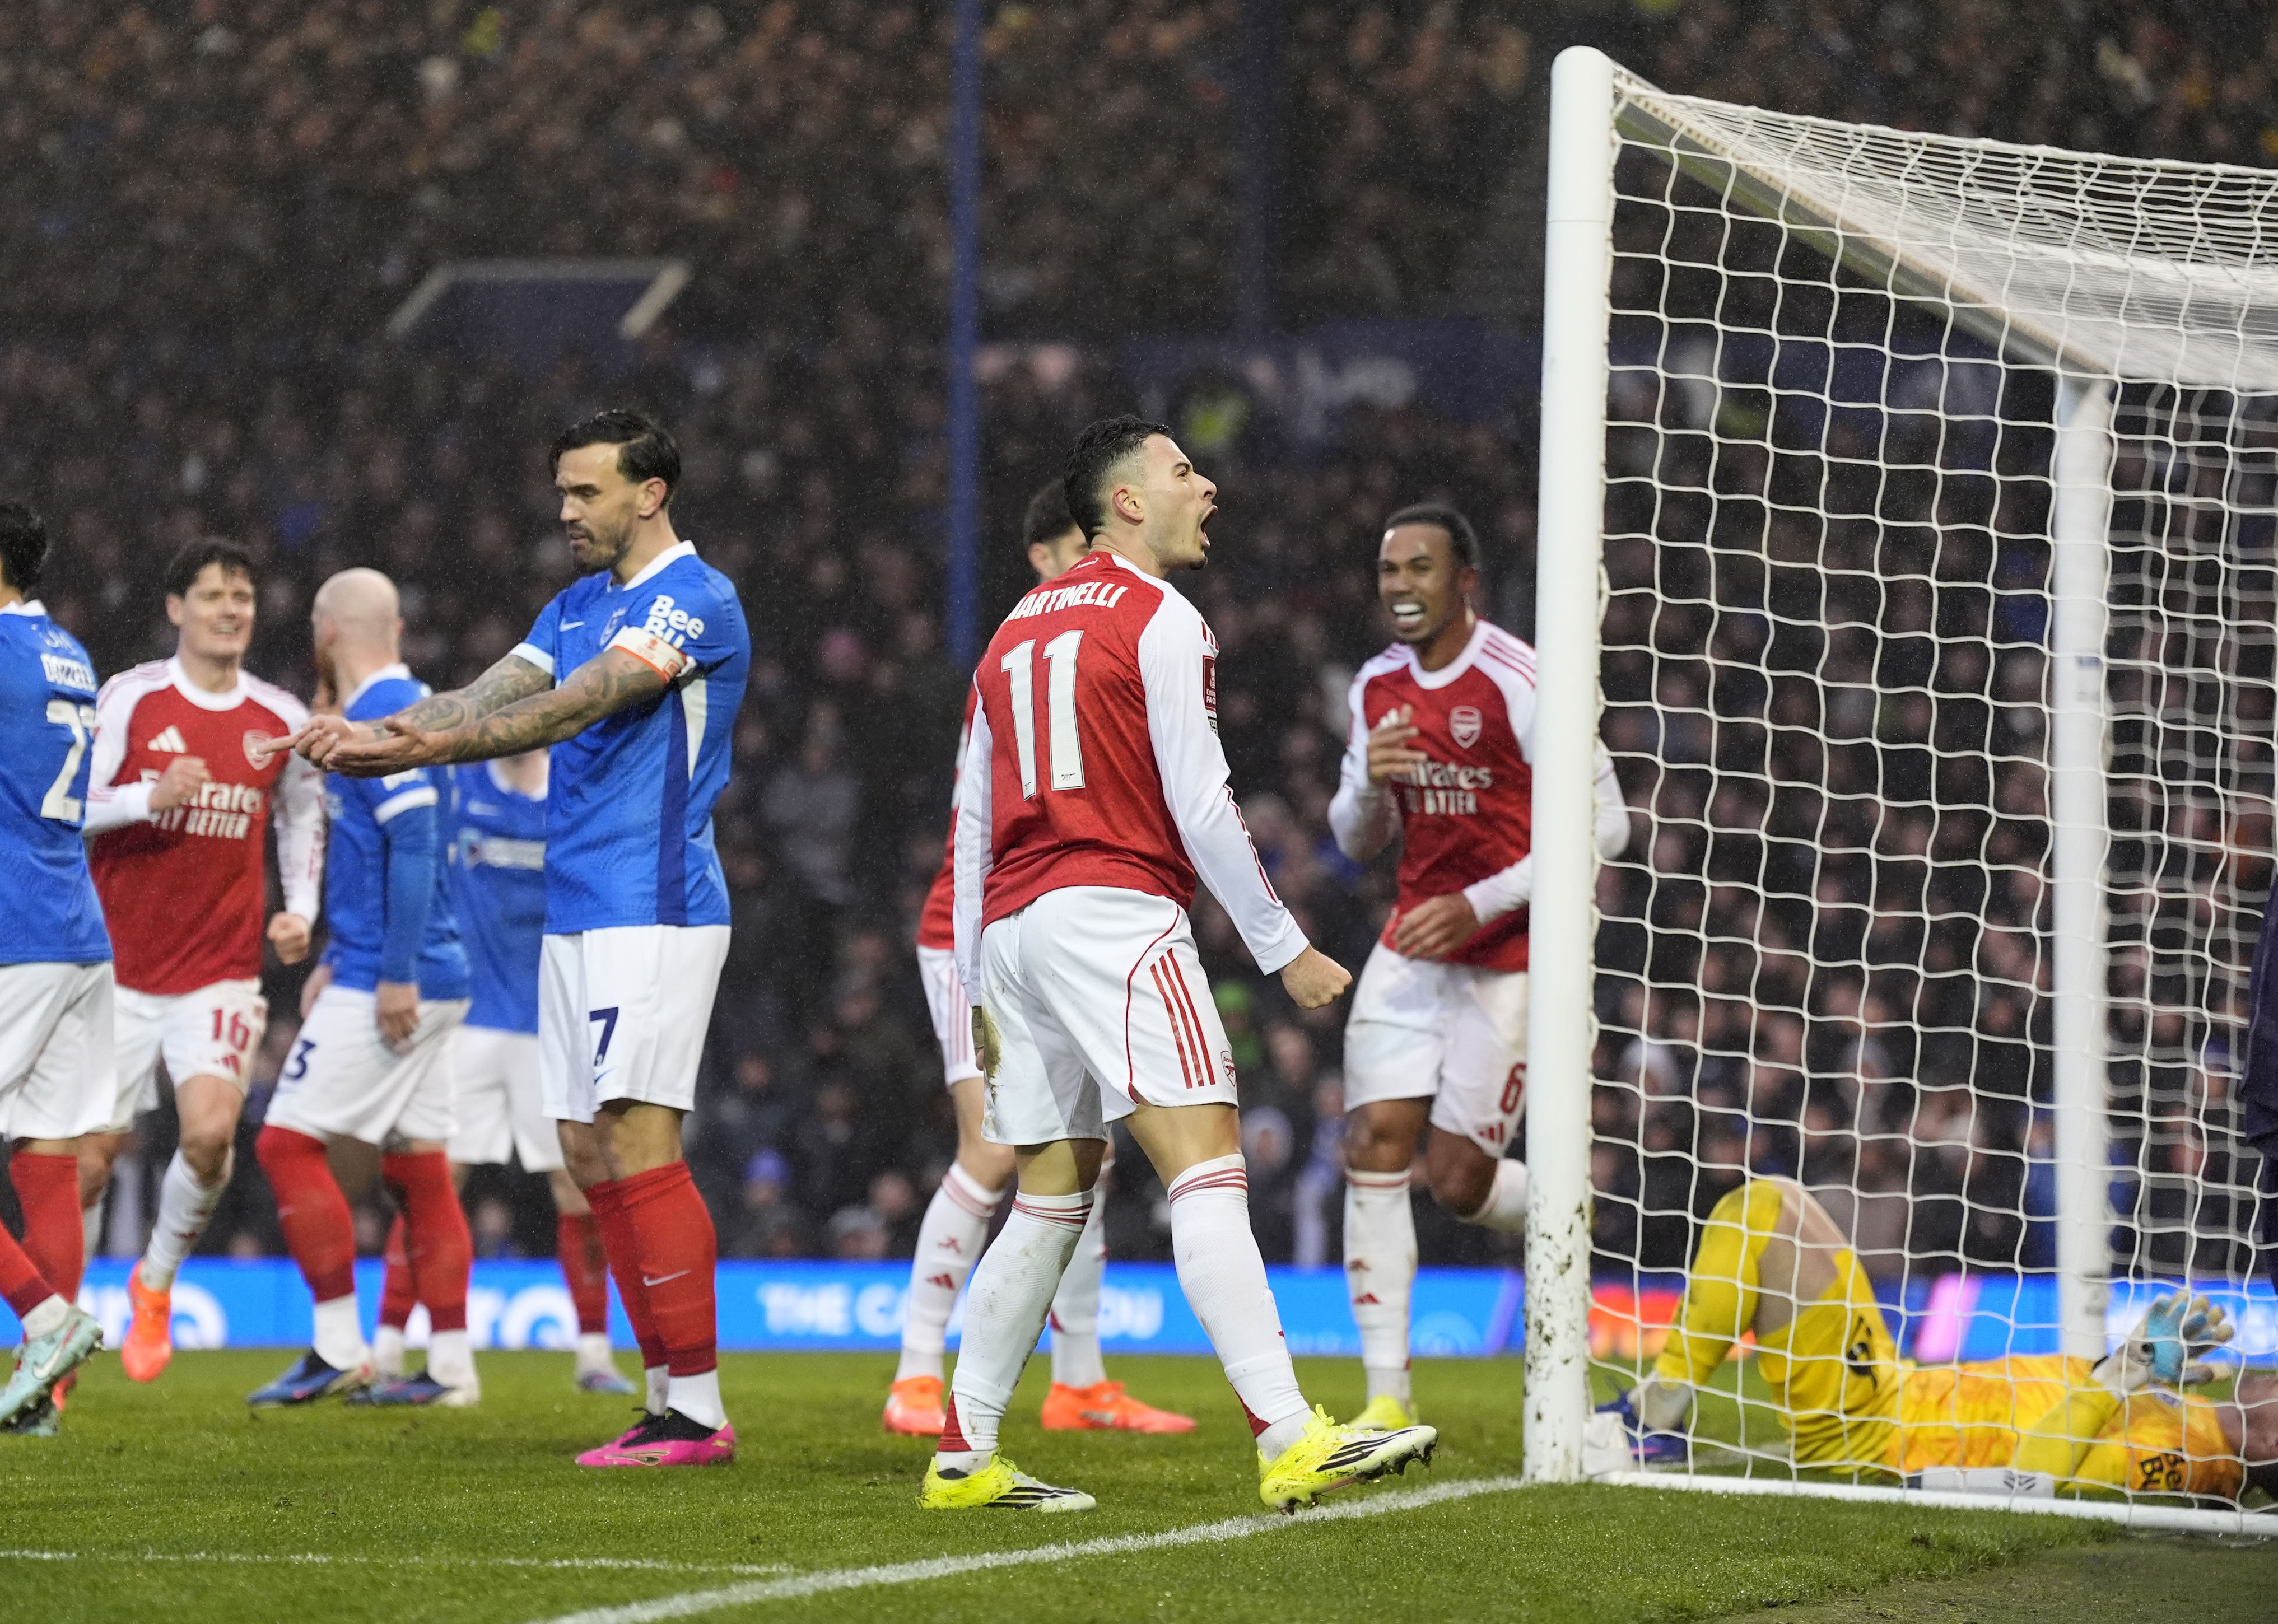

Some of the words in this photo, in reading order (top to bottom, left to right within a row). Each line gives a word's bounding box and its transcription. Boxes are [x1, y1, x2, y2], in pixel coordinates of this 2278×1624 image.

[649, 594, 705, 640] Bee
[1001, 629, 1086, 802] 11
[41, 699, 95, 823] 2
[212, 1008, 250, 1052] 16
[588, 1006, 619, 1067] 7
[1499, 1062, 1527, 1114] 6
